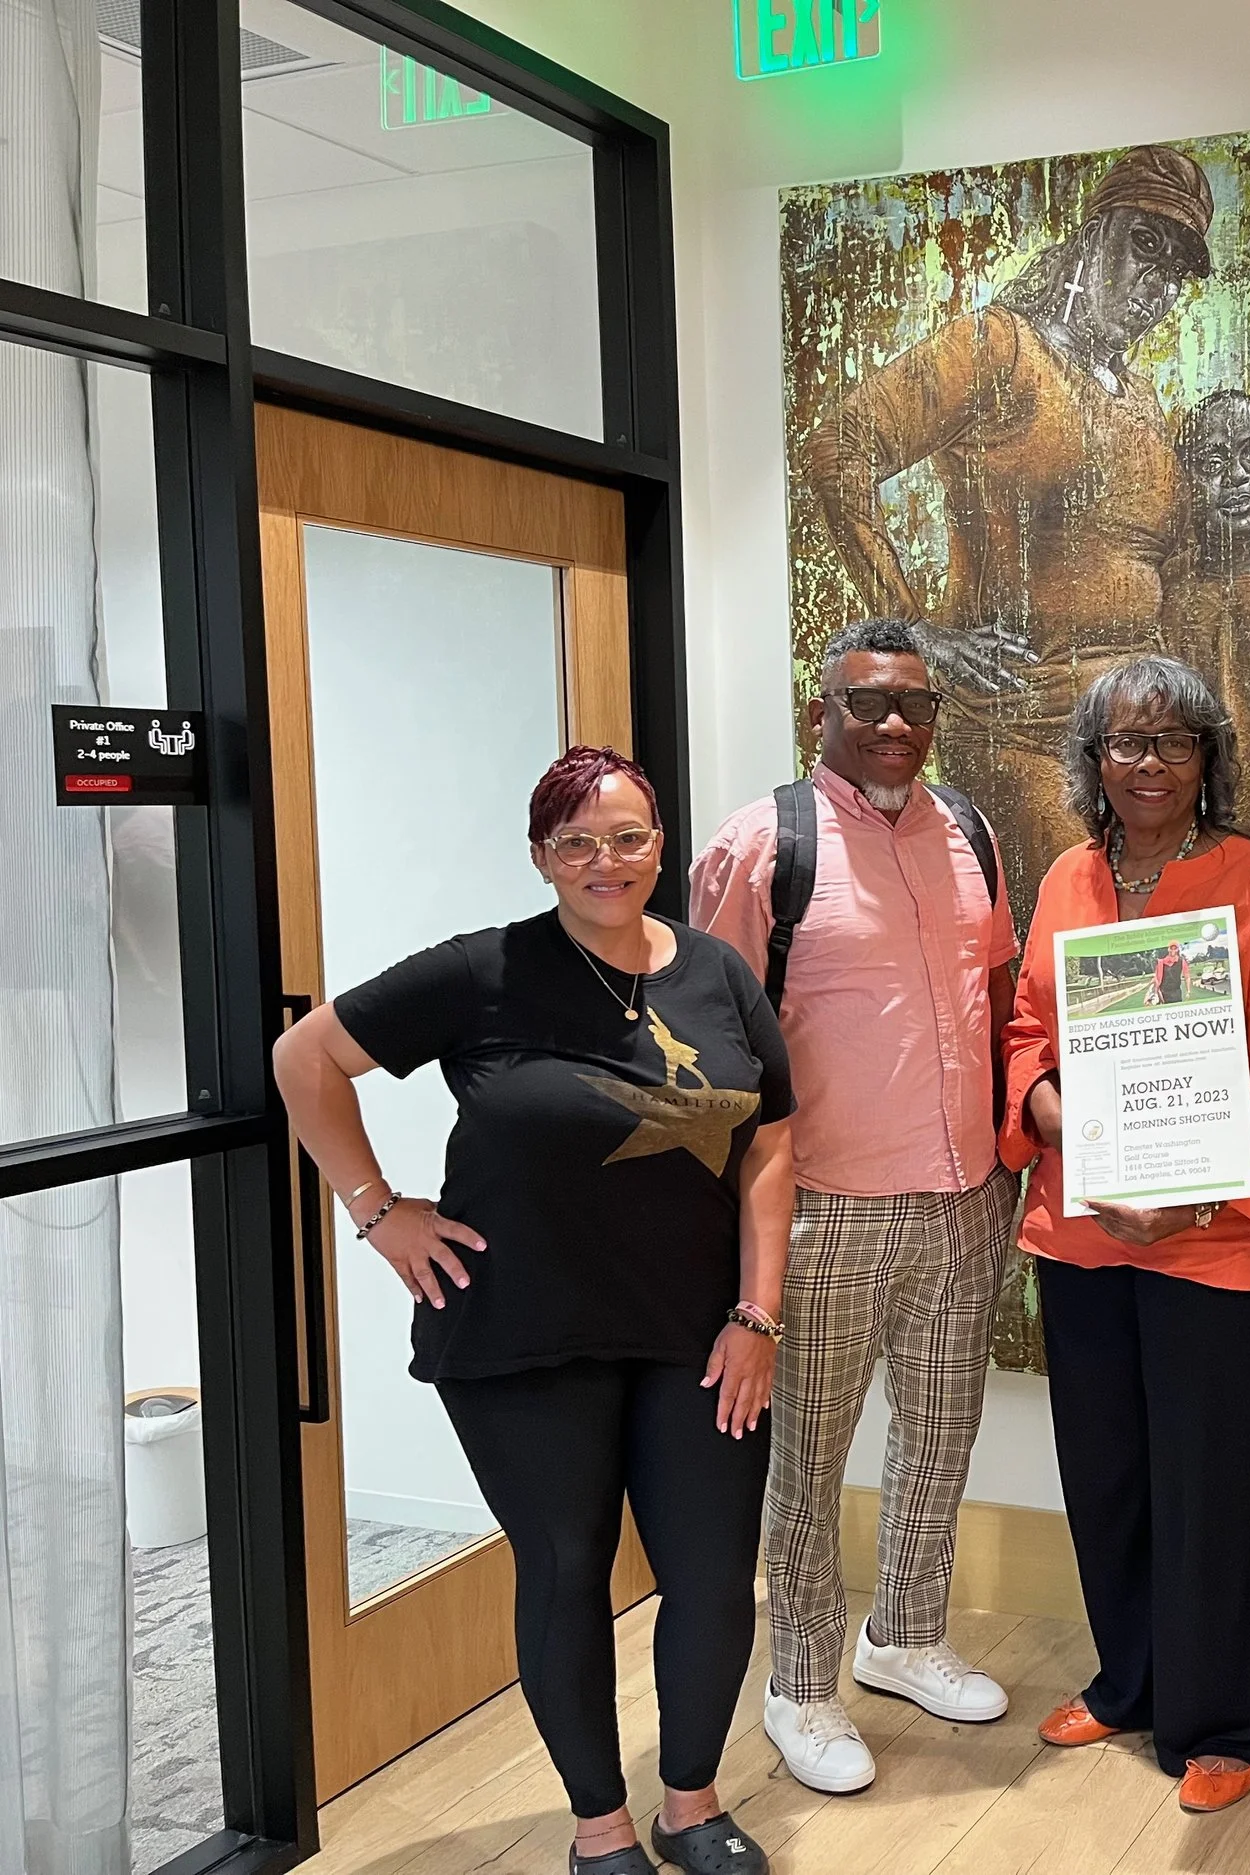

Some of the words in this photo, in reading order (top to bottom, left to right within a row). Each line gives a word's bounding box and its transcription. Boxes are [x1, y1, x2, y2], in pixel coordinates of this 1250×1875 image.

[69, 719, 105, 731] Private
[106, 721, 135, 732] Office
[95, 735, 111, 746] #1
[77, 748, 97, 759] 2-4
[98, 750, 131, 762] people
[76, 779, 118, 787] OCCUPIED
[1068, 1022, 1097, 1034] BIDDY
[1099, 1017, 1135, 1030] MASON
[1137, 1013, 1162, 1025] GOLF
[1165, 1004, 1233, 1021] TOURNAMENT
[1068, 1026, 1168, 1055] REGISTER
[1174, 1017, 1235, 1041] NOW!
[1121, 1076, 1193, 1096] MONDAY
[632, 1091, 744, 1110] HAMILTON
[1123, 1097, 1162, 1113] AUG.
[1167, 1094, 1189, 1108] 21,
[1194, 1088, 1229, 1104] 2023
[1123, 1116, 1177, 1131] MORNING
[1179, 1110, 1231, 1125] SHOTGUN
[1142, 1151, 1170, 1160] Course
[1124, 1174, 1137, 1182] Los
[1174, 1168, 1187, 1176] CA
